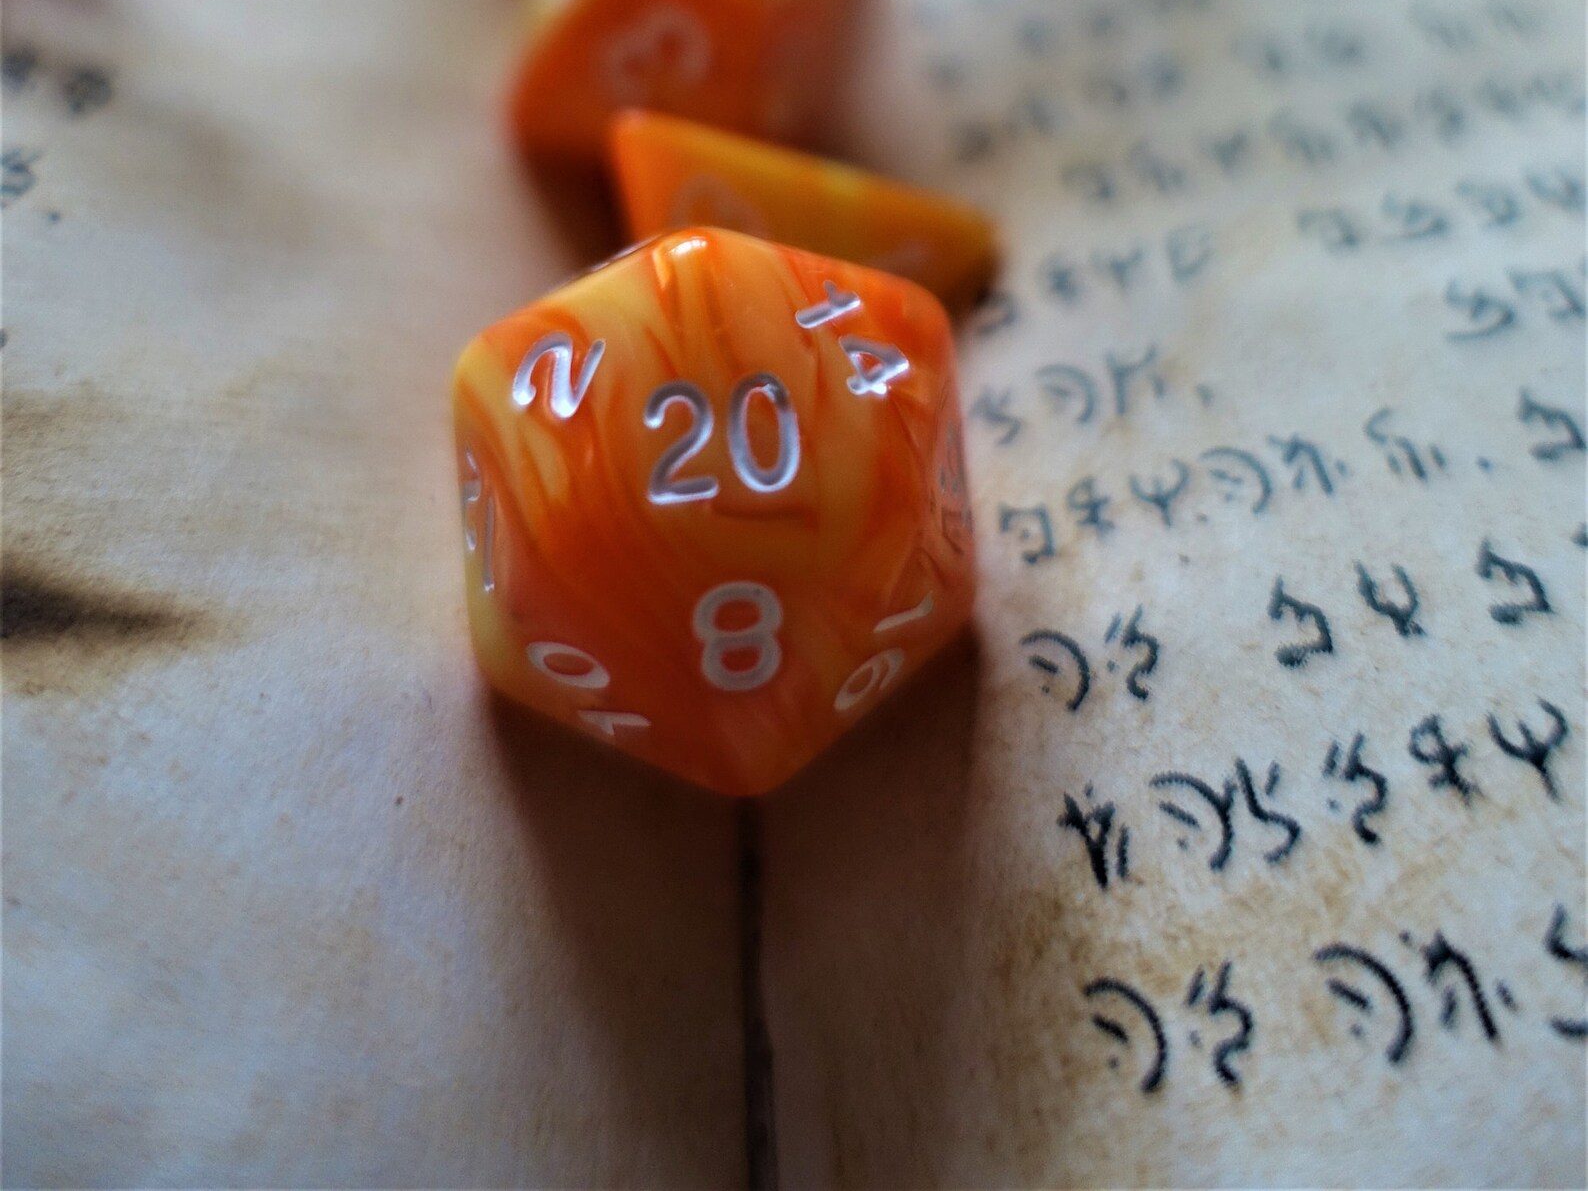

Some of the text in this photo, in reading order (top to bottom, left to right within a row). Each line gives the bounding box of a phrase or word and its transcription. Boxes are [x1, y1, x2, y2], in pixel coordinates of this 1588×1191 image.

[512, 330, 607, 418] 2
[795, 279, 911, 396] 14
[644, 371, 802, 507] 20
[525, 640, 652, 736] 10
[692, 580, 784, 692] 8
